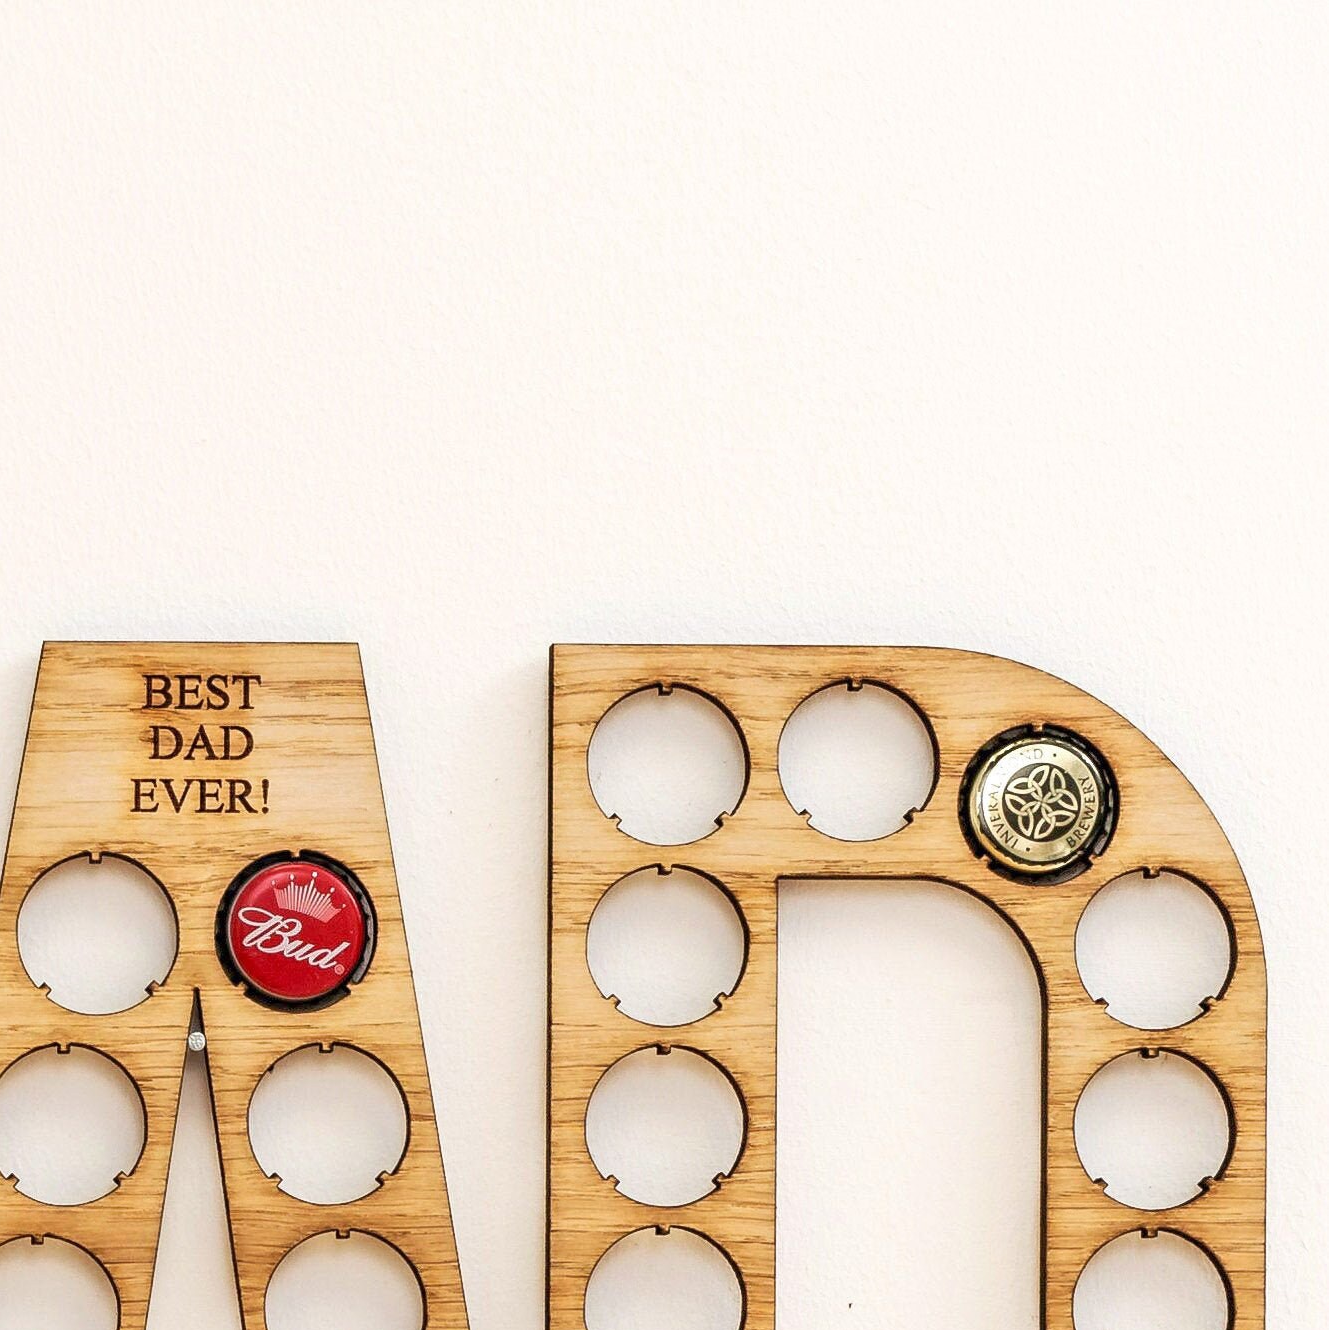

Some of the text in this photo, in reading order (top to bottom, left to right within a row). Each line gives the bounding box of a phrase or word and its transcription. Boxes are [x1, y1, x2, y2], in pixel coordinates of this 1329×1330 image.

[141, 674, 262, 710] BEST
[149, 724, 254, 760] DAD
[130, 778, 270, 814] EVER!
[1066, 776, 1096, 848] BREWERY
[237, 906, 350, 969] Bud
